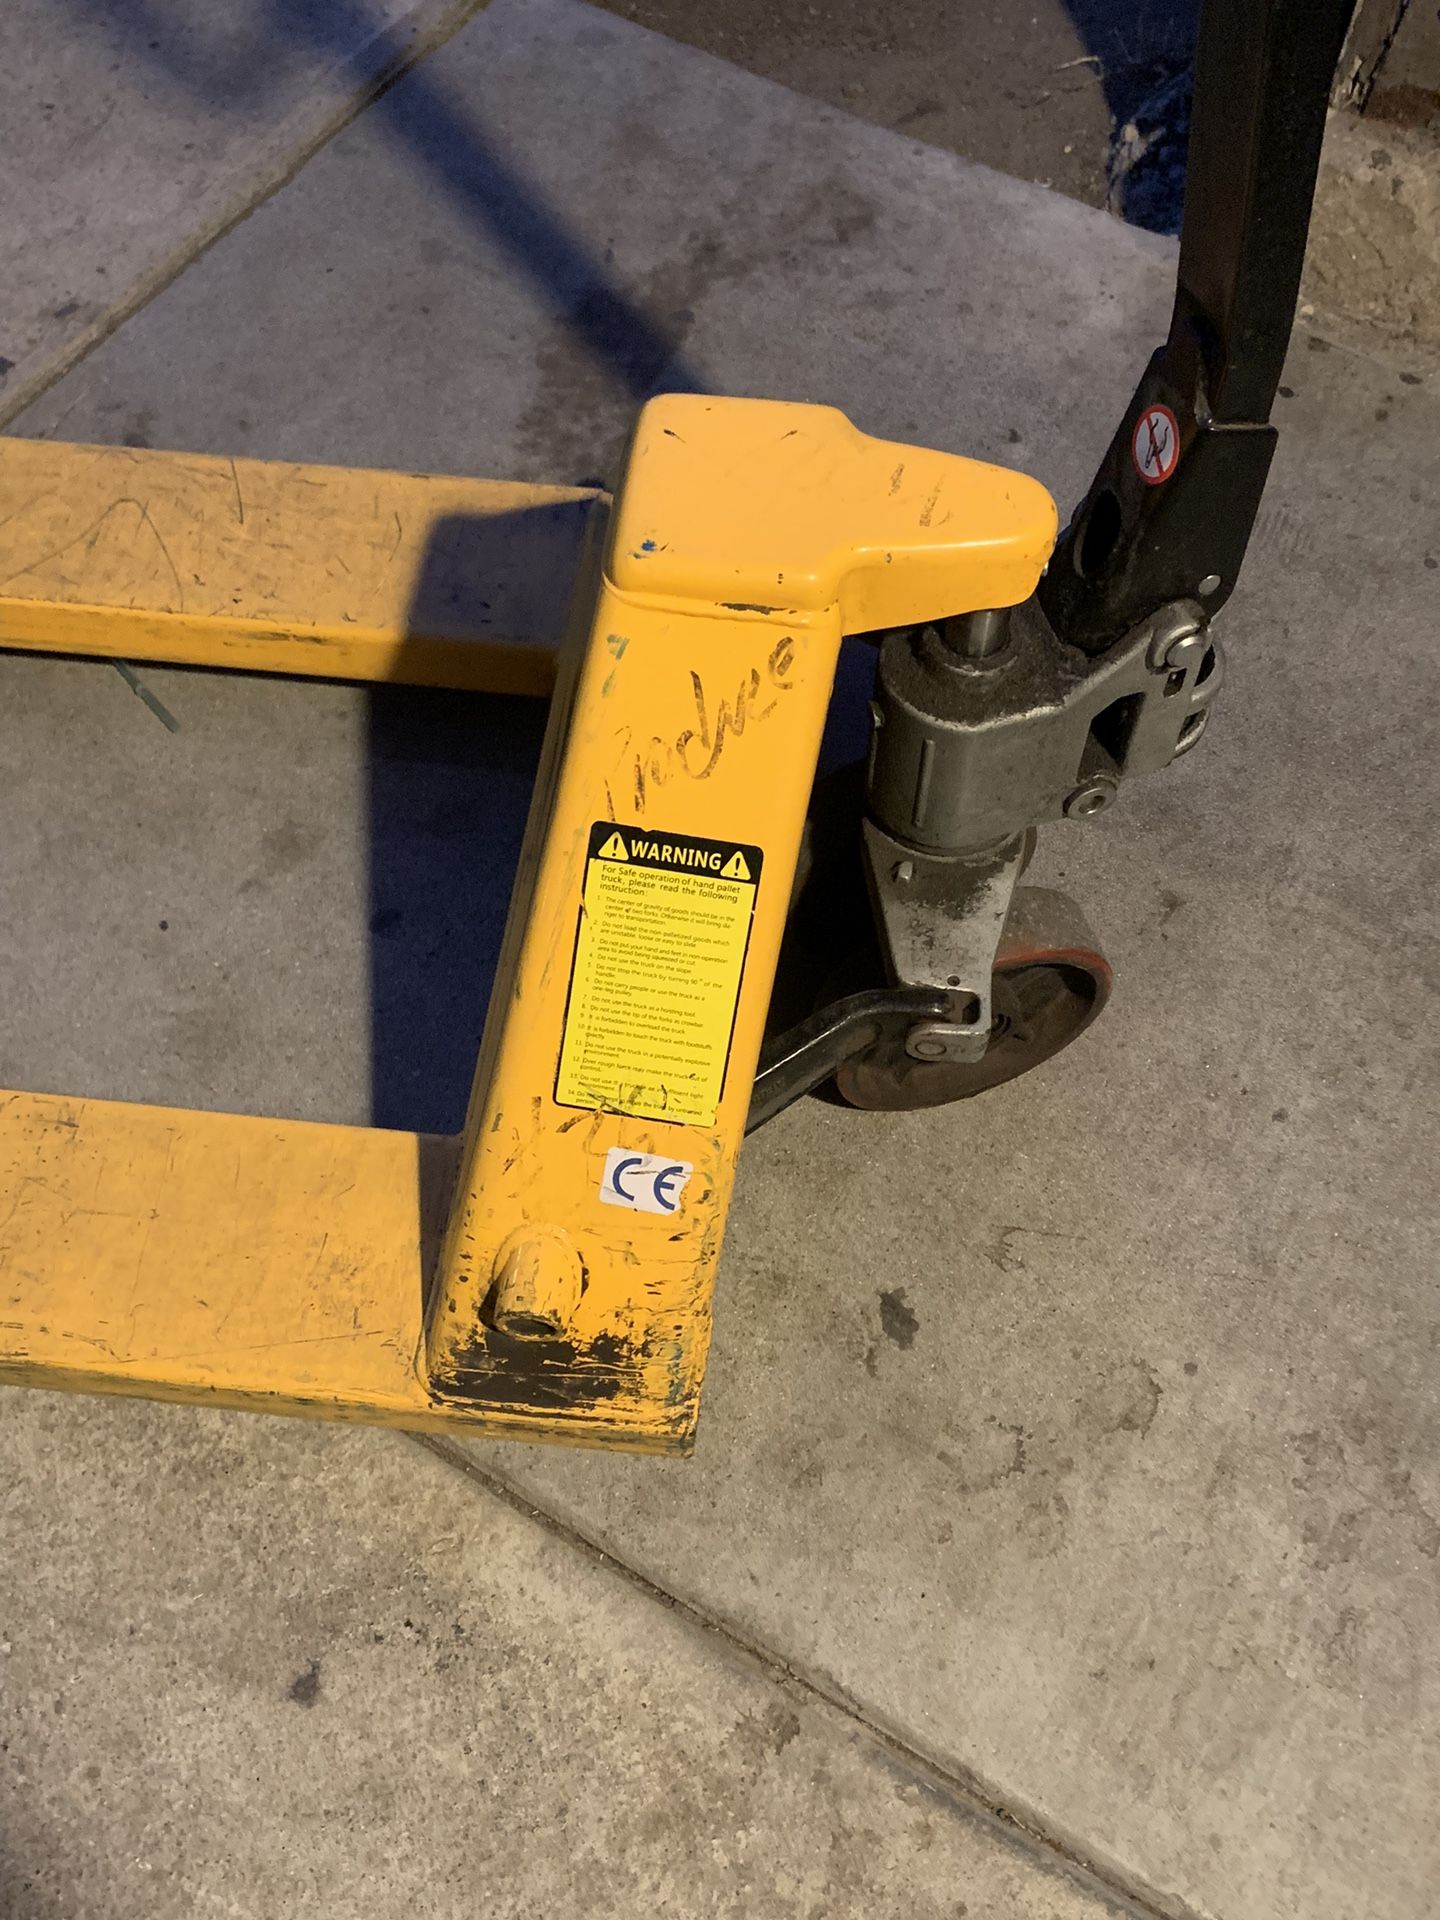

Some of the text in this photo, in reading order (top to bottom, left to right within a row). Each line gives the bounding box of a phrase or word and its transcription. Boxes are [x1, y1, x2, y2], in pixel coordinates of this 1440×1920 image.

[631, 840, 722, 870] WARNING
[599, 882, 648, 896] instruction:
[600, 873, 738, 904] truck, please read the following
[601, 864, 740, 894] For Safe operation of hand pallet
[612, 1157, 684, 1211] CE
